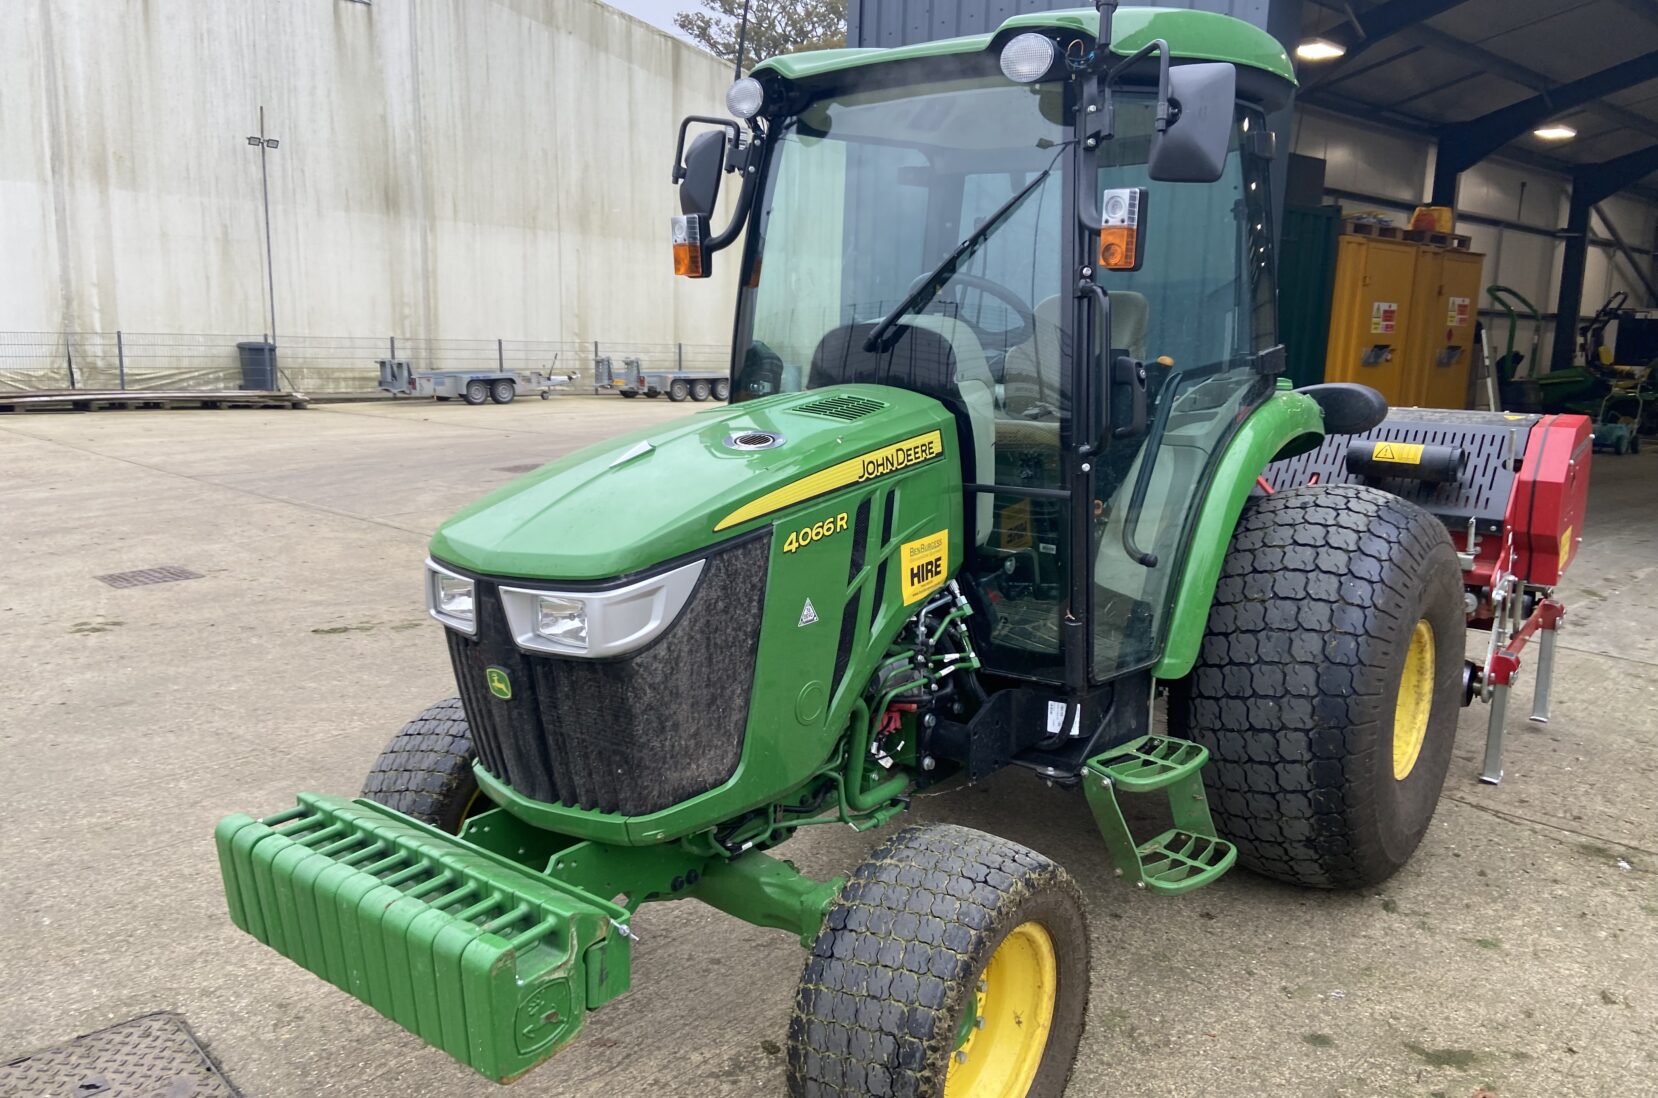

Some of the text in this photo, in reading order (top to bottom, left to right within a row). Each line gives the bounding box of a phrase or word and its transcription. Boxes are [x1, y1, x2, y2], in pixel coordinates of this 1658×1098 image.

[858, 441, 935, 479] JOHN DEERE
[783, 512, 848, 553] 4066R
[910, 556, 942, 587] HIRE
